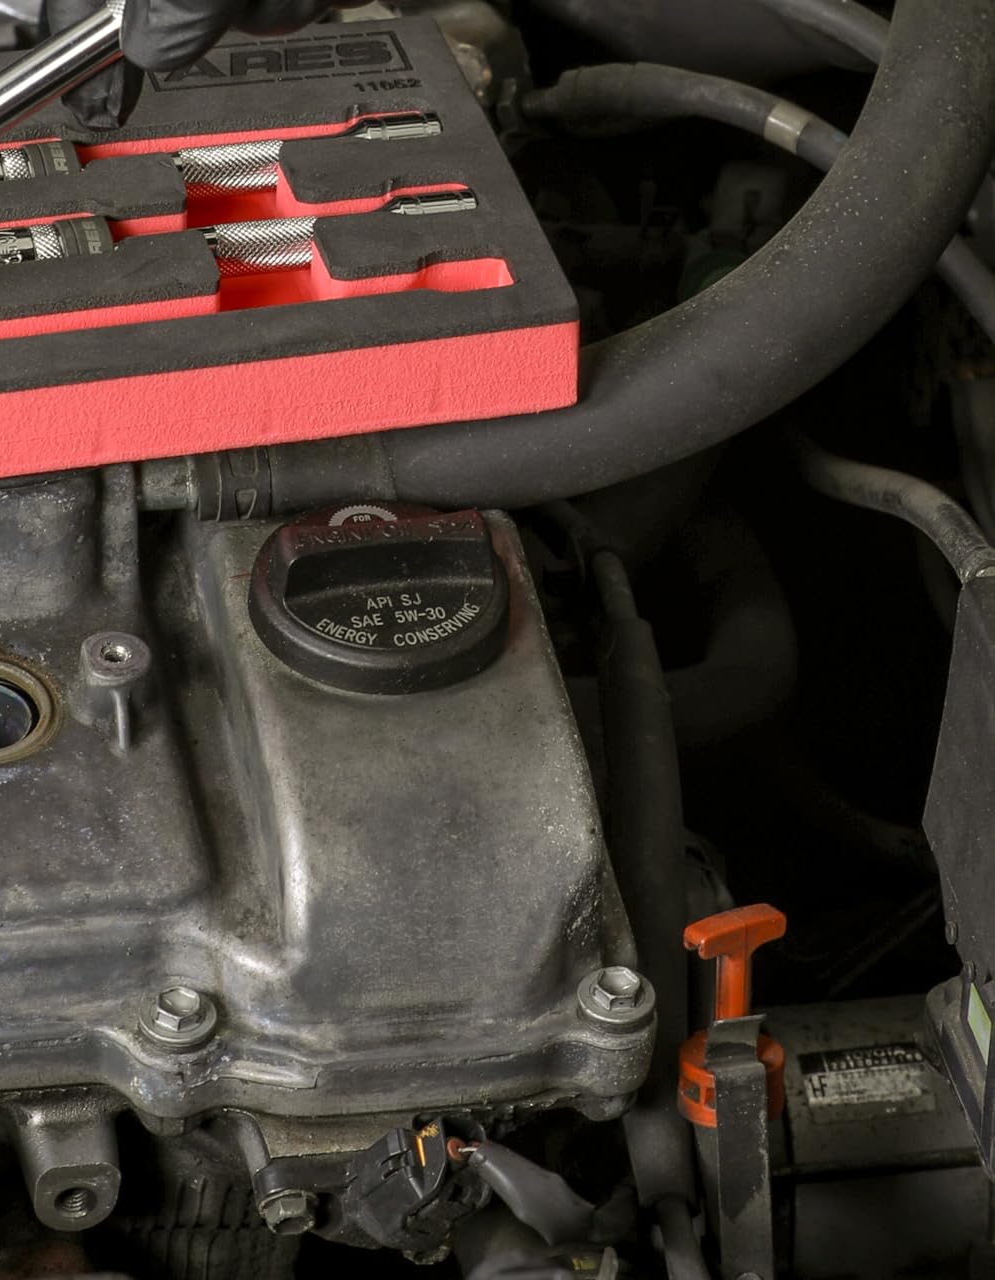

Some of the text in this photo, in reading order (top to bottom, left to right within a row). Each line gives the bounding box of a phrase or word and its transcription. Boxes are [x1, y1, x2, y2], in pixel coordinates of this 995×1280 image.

[162, 38, 393, 83] ARES
[353, 514, 372, 523] FOR
[366, 593, 422, 610] API SJ
[315, 602, 481, 648] ENERGY CONSERVING
[350, 606, 446, 629] SAE 5W-30
